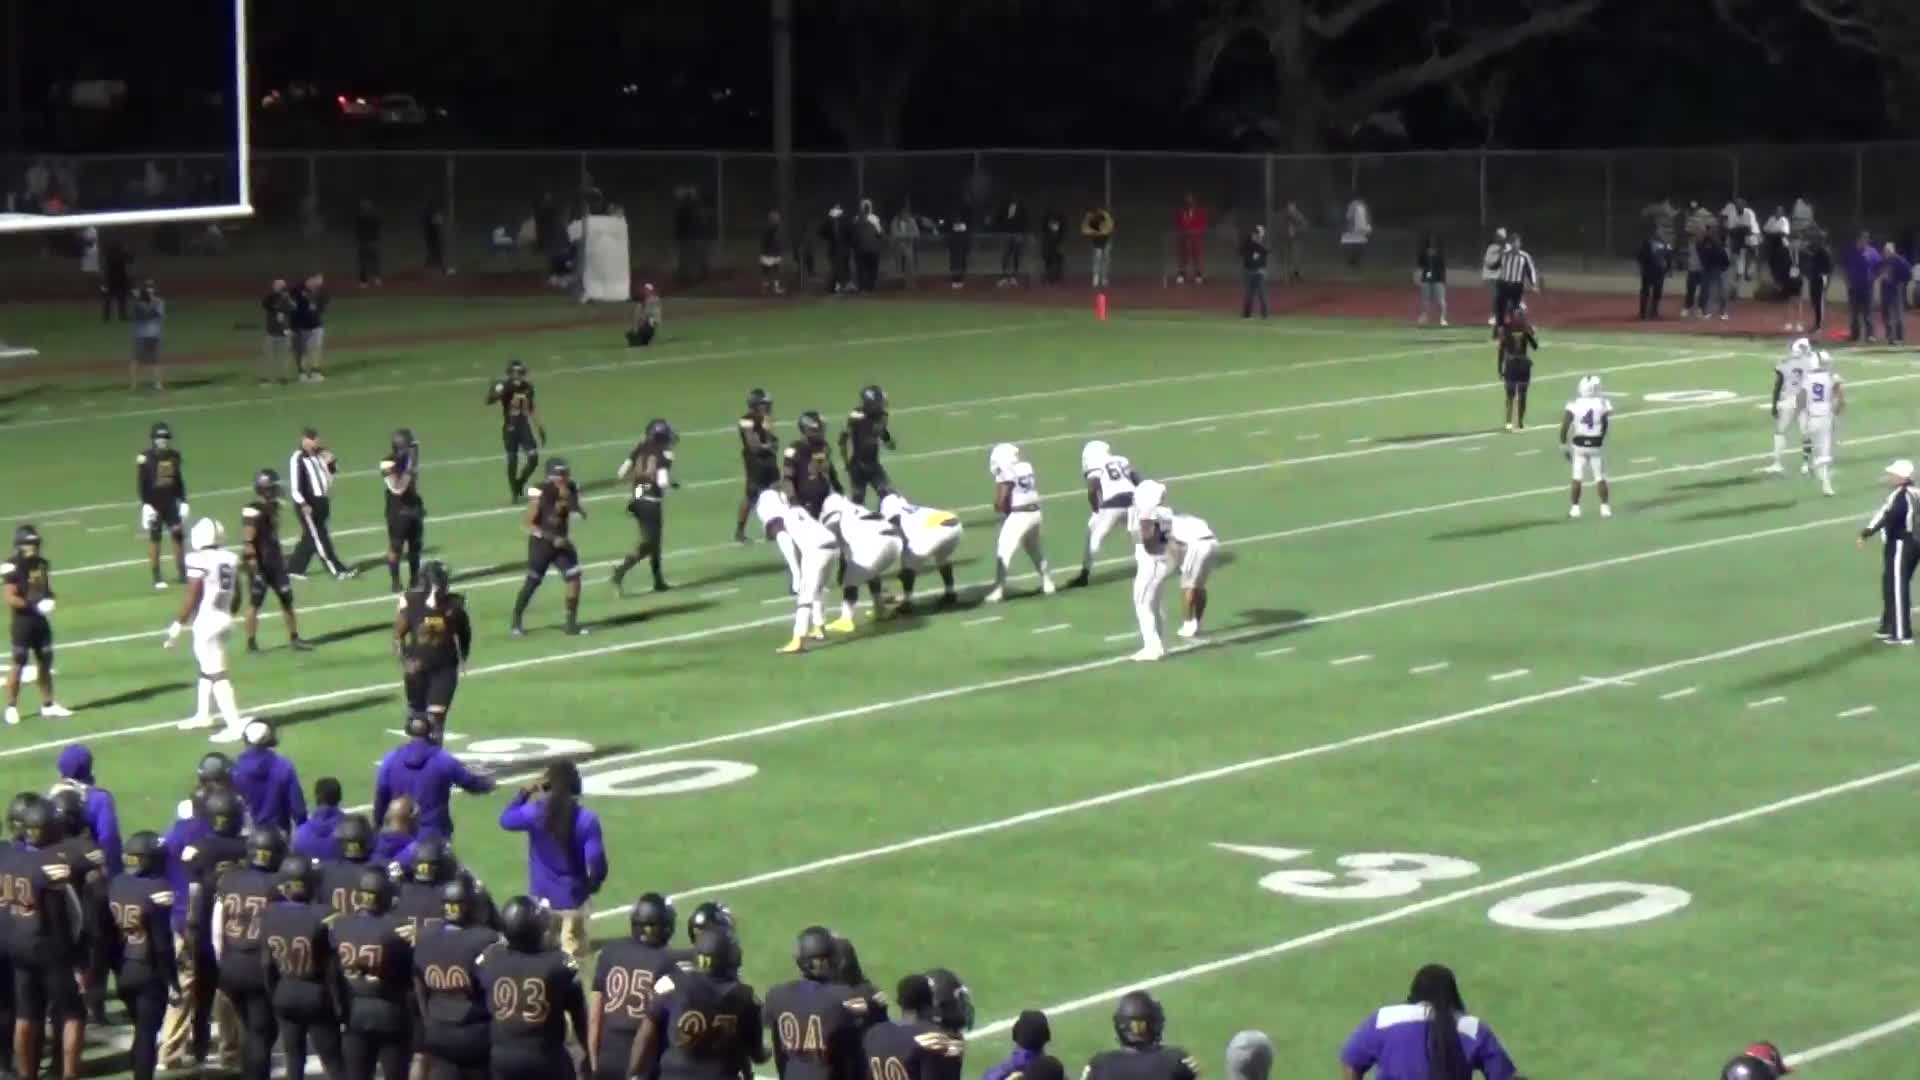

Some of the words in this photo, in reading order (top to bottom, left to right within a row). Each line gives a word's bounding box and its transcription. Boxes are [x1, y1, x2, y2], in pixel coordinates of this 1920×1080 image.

[1811, 382, 1826, 402] 9
[1578, 412, 1596, 431] 4
[493, 976, 548, 1023] 93
[604, 966, 653, 1018] 95
